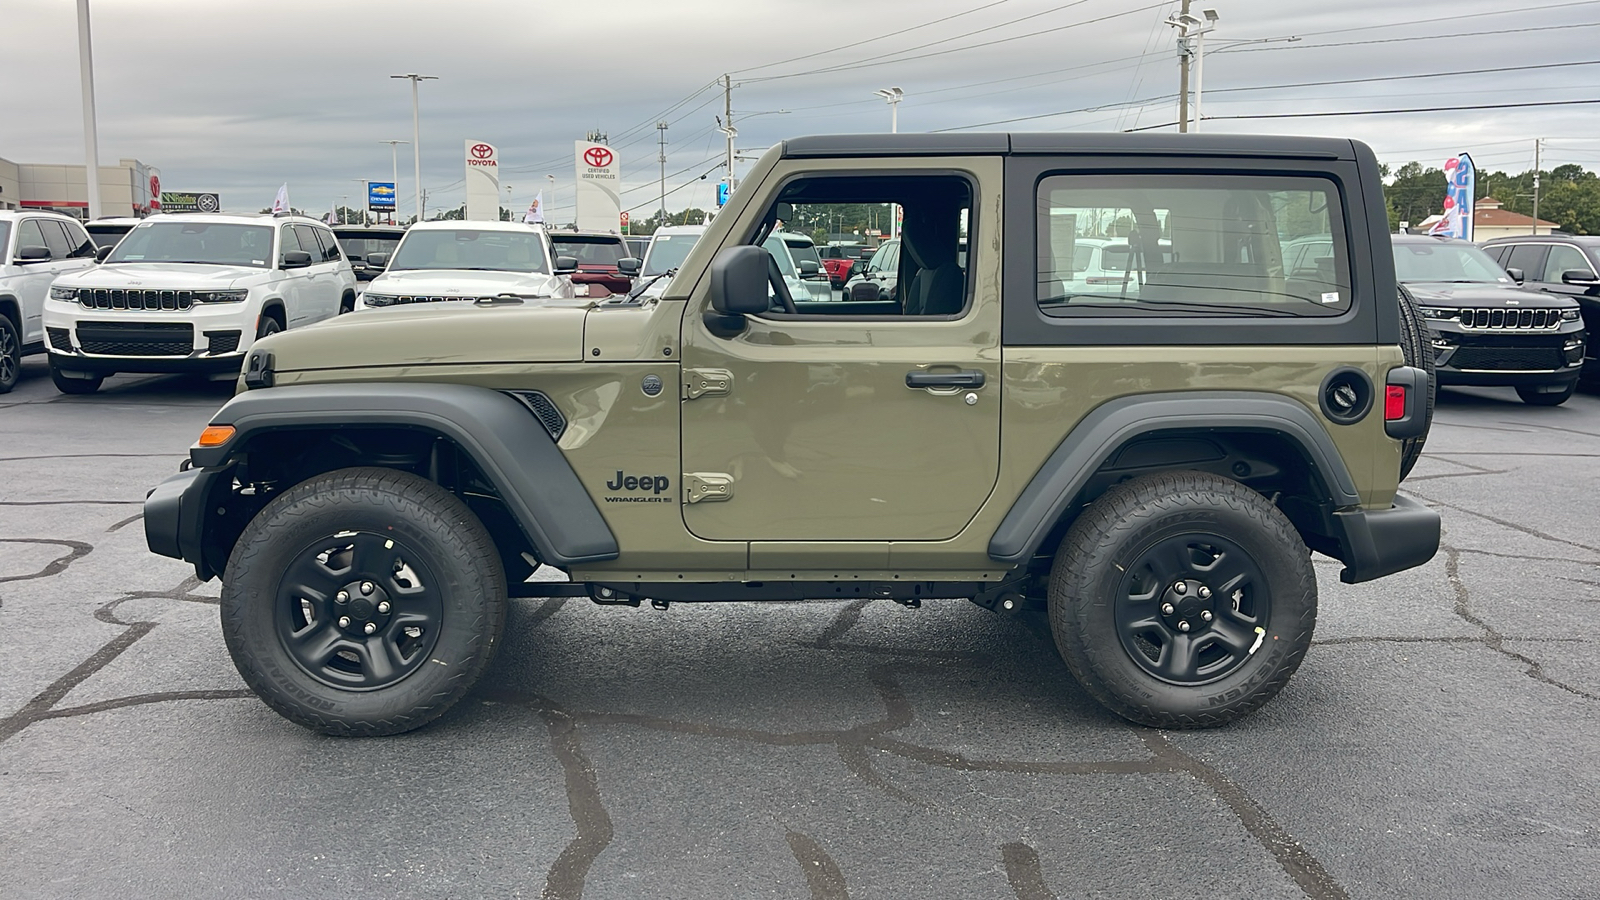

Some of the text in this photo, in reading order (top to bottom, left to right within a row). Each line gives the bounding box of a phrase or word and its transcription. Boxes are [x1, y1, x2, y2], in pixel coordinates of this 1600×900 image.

[467, 159, 497, 167] TOYOTA
[606, 469, 670, 495] Jeep
[1207, 649, 1282, 706] NEXEN
